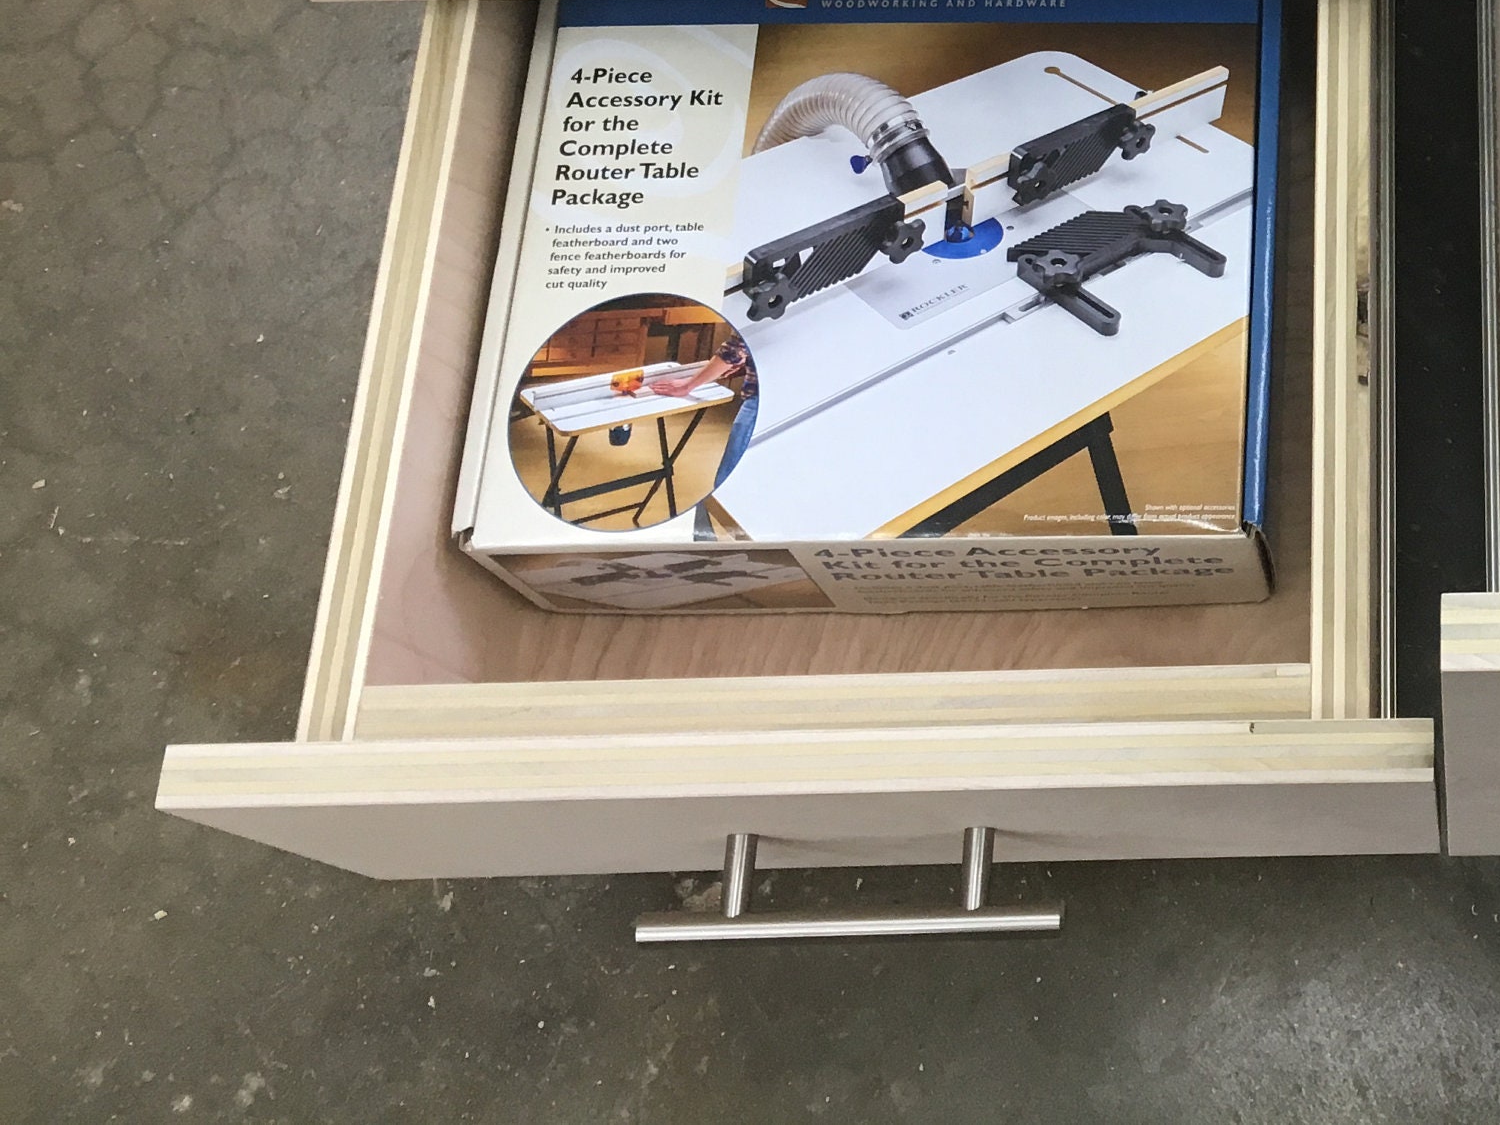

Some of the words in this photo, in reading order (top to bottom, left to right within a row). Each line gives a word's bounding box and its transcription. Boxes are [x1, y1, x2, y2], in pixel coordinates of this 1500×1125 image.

[821, 0, 938, 8] WOODWORKING
[946, 0, 976, 8] AND
[571, 68, 653, 84] 4-Piece
[566, 92, 682, 111] Accessory
[690, 90, 724, 106] Kit
[562, 116, 596, 132] for
[602, 115, 639, 132] the
[559, 139, 673, 160] Complete
[555, 164, 636, 181] Router
[640, 162, 700, 179] Table
[552, 188, 644, 210] Package
[554, 225, 602, 234] Includes
[616, 224, 640, 234] dust
[643, 224, 673, 235] port,
[675, 222, 704, 232] table
[552, 237, 628, 248] featherboard
[632, 236, 653, 246] and
[656, 238, 679, 246] two
[550, 252, 582, 262] fence
[584, 250, 666, 262] featherboards
[669, 250, 687, 260] for
[548, 266, 582, 276] safety
[584, 264, 607, 274] and
[610, 264, 666, 276] improved
[545, 281, 564, 289] cut
[567, 279, 608, 290] quality
[910, 284, 968, 312] ROCKLER
[1178, 504, 1203, 512] optional
[1070, 514, 1096, 522] including
[814, 548, 956, 558] 4-Piece
[966, 547, 1160, 557] Accessory
[821, 560, 881, 570] Kit
[892, 560, 946, 570] for
[960, 559, 1020, 568] the
[1034, 556, 1224, 568] Complete
[832, 572, 963, 582] Router
[968, 570, 1070, 579] Table
[1084, 567, 1234, 577] Package
